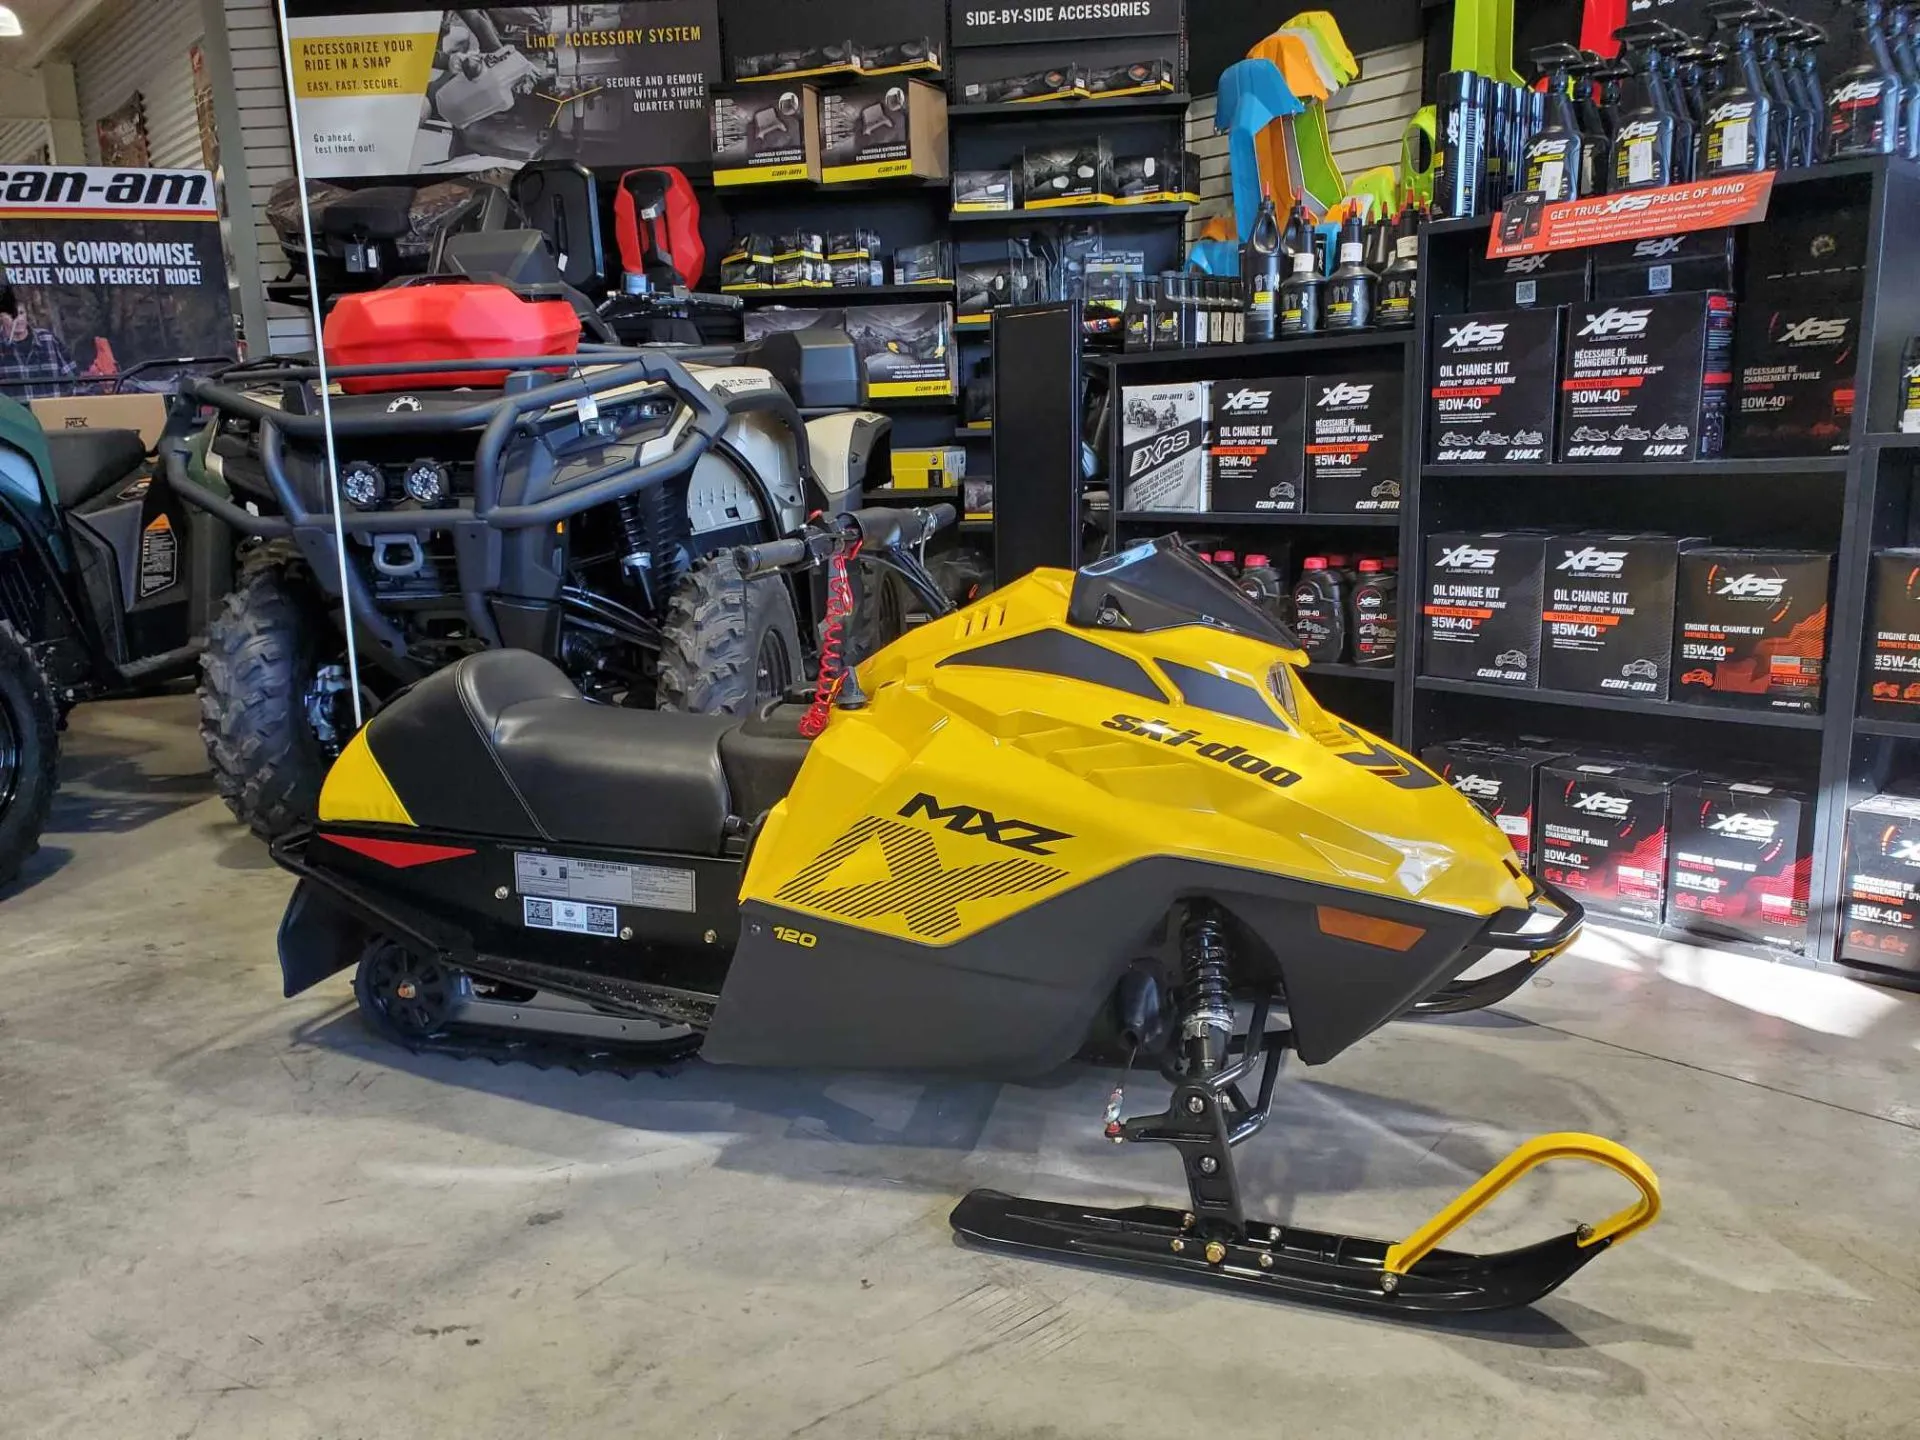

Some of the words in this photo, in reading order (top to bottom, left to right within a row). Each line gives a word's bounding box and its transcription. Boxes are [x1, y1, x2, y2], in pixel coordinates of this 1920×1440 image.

[966, 7, 1053, 26] SIDE-BY-SIDE
[1058, 2, 1150, 21] ACCESSORIES
[565, 30, 642, 47] ACCESSORY
[649, 26, 700, 43] SYSTEM
[303, 41, 379, 56] ACCESSORIZE
[384, 40, 413, 52] YOUR
[305, 59, 332, 72] RIDE
[336, 59, 348, 70] IN
[352, 59, 359, 69] A
[363, 57, 391, 70] SNAP
[307, 81, 332, 92] EASY.
[336, 80, 360, 90] FAST.
[363, 78, 402, 90] SECURE.
[606, 77, 641, 88] SECURE
[645, 76, 663, 87] AND
[667, 73, 703, 86] REMOVE
[635, 88, 658, 99] WITH
[671, 86, 704, 98] SIMPLE
[1829, 80, 1886, 105] XPS
[633, 101, 674, 113] QUARTER
[678, 99, 705, 110] TURN.
[1705, 102, 1756, 125] XPS
[1448, 107, 1459, 147] XPS
[1616, 121, 1662, 143] XPS
[313, 133, 324, 143] Go
[315, 145, 332, 154] test
[335, 144, 355, 153] them
[1525, 139, 1570, 159] XPS
[0, 171, 207, 205] an-am
[1551, 209, 1570, 221] GET
[1574, 205, 1601, 217] TRUE
[1600, 194, 1654, 217] XPS
[1652, 192, 1689, 205] PEACE
[1693, 188, 1709, 199] OF
[1711, 182, 1745, 196] MIND
[0, 241, 58, 264] NEVER
[63, 242, 201, 265] COMPROMISE.
[5, 267, 52, 284] REATE
[54, 267, 95, 284] YOUR
[99, 268, 160, 284] PERFECT
[164, 269, 202, 285] RIDE!
[1577, 308, 1653, 336] XPS
[1777, 316, 1850, 342] XPS
[1442, 322, 1509, 348] XPS
[1589, 333, 1646, 342] LUBRICANTS
[1453, 345, 1504, 353] LUBRICANTS
[1575, 348, 1616, 360] NÉCESSAIRE
[1617, 347, 1627, 357] DE
[1574, 357, 1619, 368] CHANGEMENT
[1620, 354, 1648, 365] D'HUILE
[1440, 365, 1454, 377] OIL
[1456, 363, 1492, 376] CHANGE
[1494, 362, 1510, 374] KIT
[1574, 369, 1601, 378] MOTEUR
[1744, 366, 1786, 375] NÉCESSAIRE
[1788, 365, 1798, 373] DE
[1493, 376, 1516, 384] ENGINE
[1743, 373, 1791, 383] CHANGEMENT
[1152, 393, 1183, 401] can-am
[1221, 388, 1272, 410] XPS
[1316, 383, 1374, 407] XPS
[1580, 389, 1620, 403] 0W-40
[1748, 396, 1785, 408] 0W-40
[1446, 397, 1482, 411] 0W-40
[1348, 418, 1355, 426] DE
[1221, 426, 1231, 437] OIL
[1232, 426, 1260, 436] CHANGE
[1261, 425, 1273, 436] KIT
[1437, 449, 1486, 460] ski-doo
[1505, 449, 1544, 460] LYNX
[1567, 445, 1622, 457] ski-doo
[1642, 444, 1687, 456] LYNX
[1225, 456, 1251, 467] 5W-40
[1321, 454, 1351, 465] 5W-40
[1256, 500, 1294, 509] can-am
[1356, 500, 1400, 509] can-am
[1435, 544, 1500, 568] XPS
[1556, 547, 1628, 572] XPS
[1568, 571, 1622, 579] LUBRICANTS
[1433, 584, 1447, 596] OIL
[1449, 585, 1484, 598] CHANGE
[1486, 587, 1500, 599] KIT
[1715, 573, 1788, 596] XPS
[1296, 593, 1315, 602] XPS
[1357, 596, 1382, 606] XPS
[1554, 588, 1569, 601] OIL
[1571, 590, 1610, 604] CHANGE
[1612, 592, 1629, 605] KIT
[1485, 601, 1507, 609] ENGINE
[1611, 607, 1635, 615] ENGINE
[1439, 617, 1473, 630] 5W-40
[1560, 623, 1597, 637] 5W-40
[1684, 623, 1709, 632] ENGINE
[1710, 624, 1720, 632] OIL
[1722, 626, 1751, 634] CHANGE
[1752, 627, 1765, 635] KIT
[1878, 631, 1907, 641] ENGINE
[1909, 633, 1920, 641] OIL
[1690, 644, 1726, 656] 5W-40
[1477, 668, 1527, 681] can-am
[1600, 677, 1657, 692] can-am
[1100, 713, 1302, 788] ski-doo
[1452, 774, 1503, 796] XPS
[1572, 791, 1633, 814] XPS
[896, 791, 1078, 856] MXZ
[1545, 824, 1580, 836] NÉCESSAIRE
[1708, 812, 1779, 838] XPS
[1545, 830, 1584, 843] CHANGEMENT
[1550, 850, 1581, 864] 0W-40
[1857, 904, 1902, 922] 5W-40
[772, 925, 817, 948] 120
